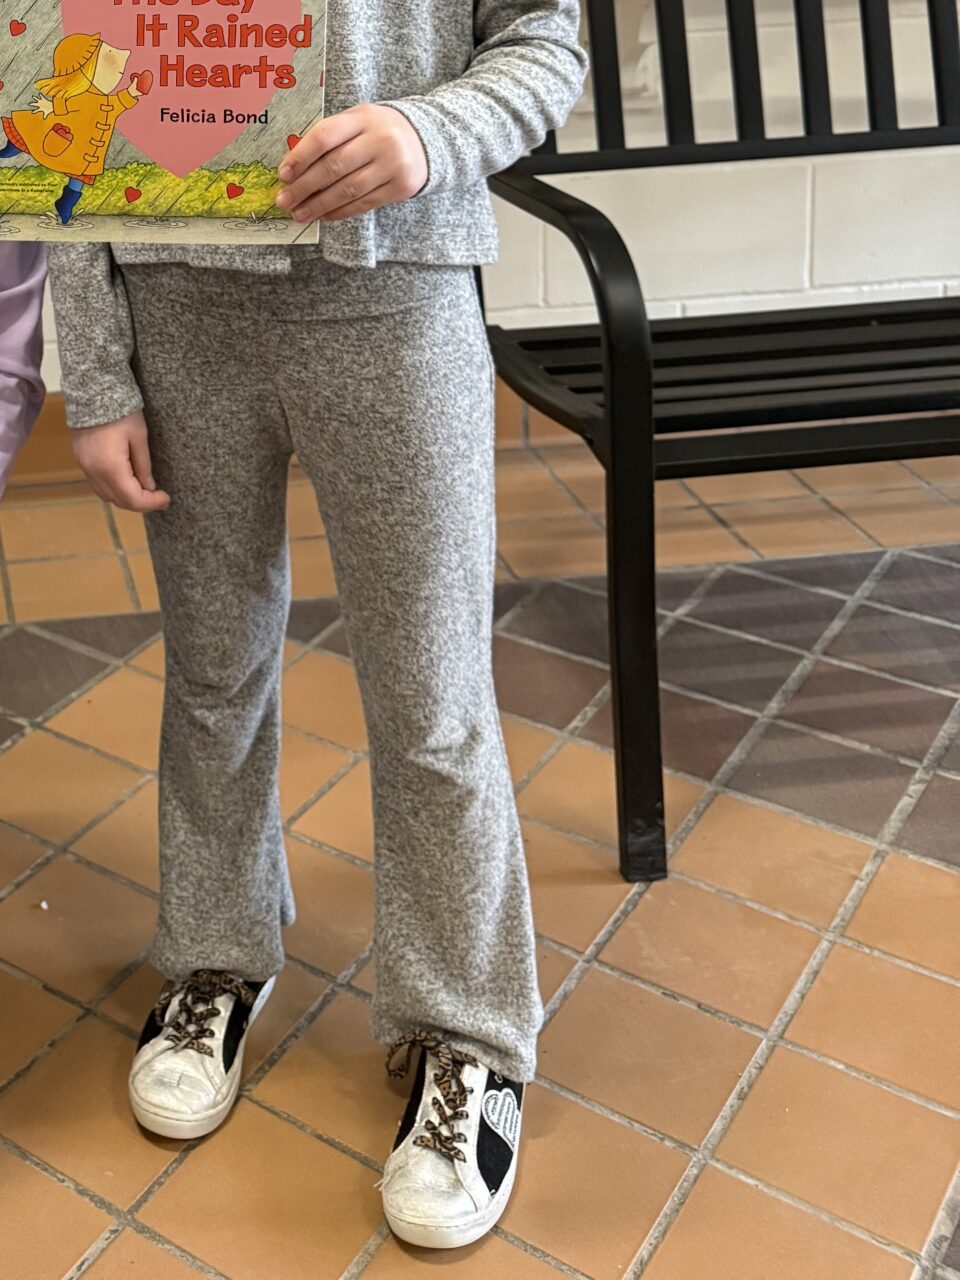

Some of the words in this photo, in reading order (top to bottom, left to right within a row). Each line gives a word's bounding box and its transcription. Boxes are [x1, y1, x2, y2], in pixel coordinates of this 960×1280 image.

[135, 14, 167, 48] It
[177, 14, 313, 49] Rained
[159, 54, 297, 89] Hearts
[160, 107, 216, 124] Felicia
[223, 109, 269, 125] Bond
